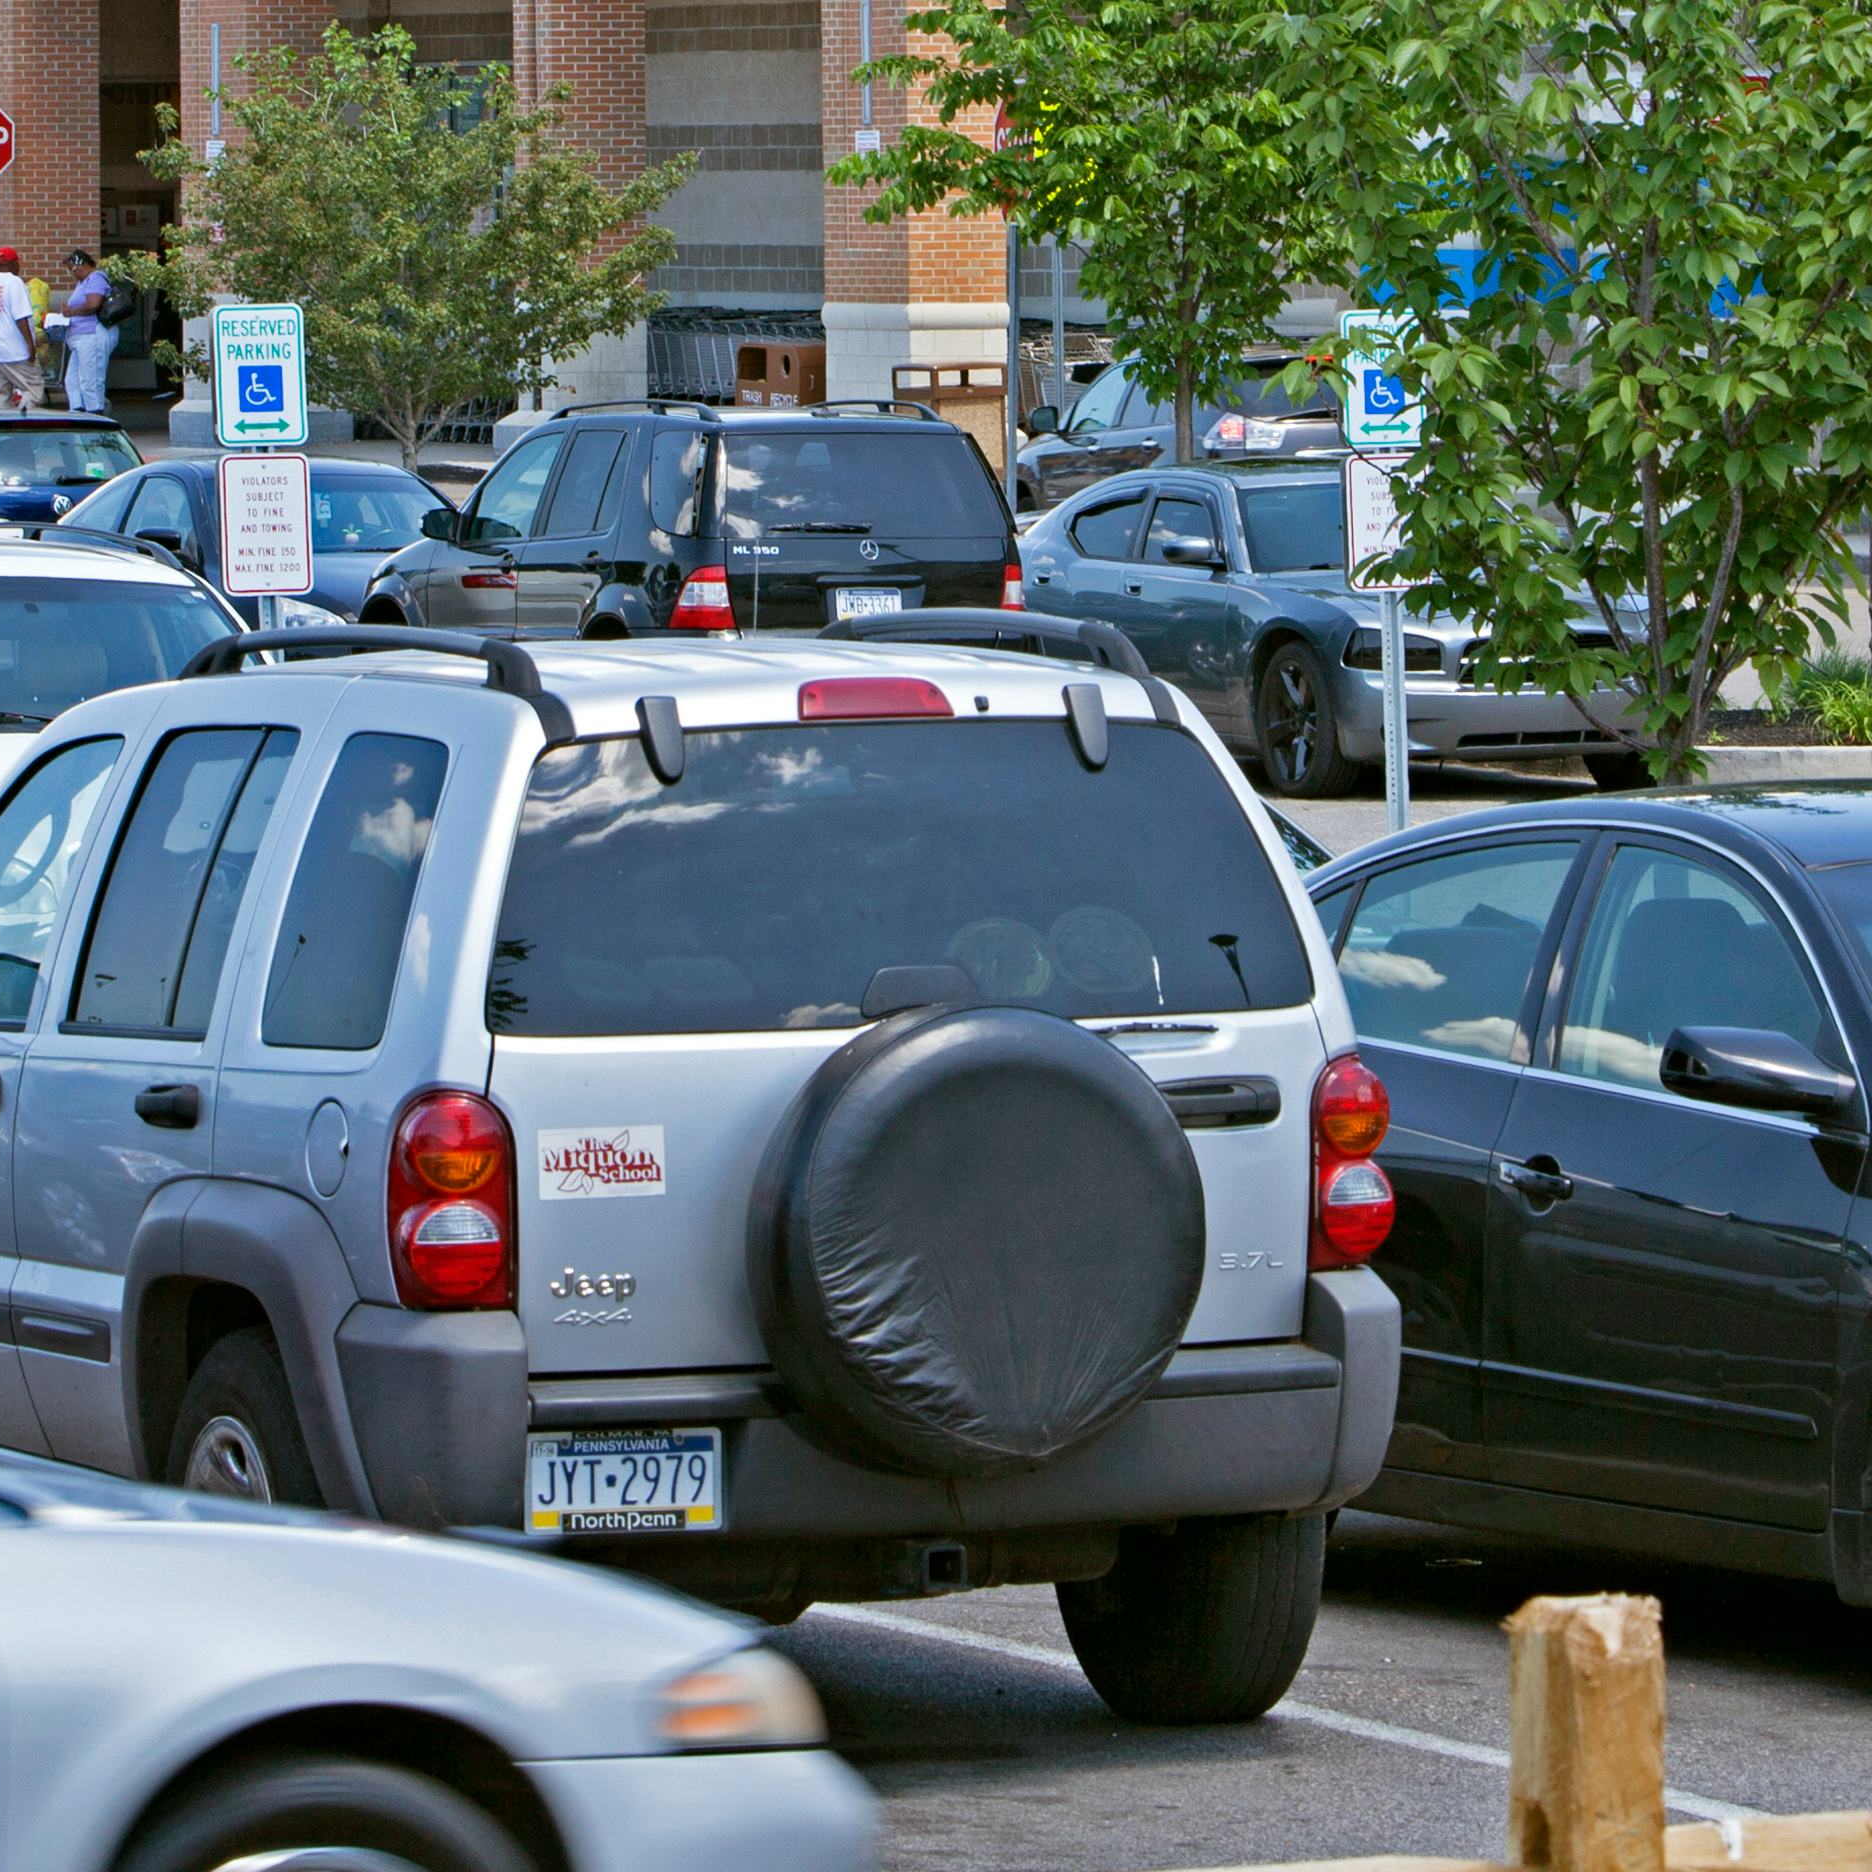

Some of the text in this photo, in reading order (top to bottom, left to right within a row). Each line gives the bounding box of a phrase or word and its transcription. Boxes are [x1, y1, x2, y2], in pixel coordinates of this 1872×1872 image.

[221, 319, 296, 337] RESERVED
[227, 343, 291, 360] PARKING
[241, 477, 289, 486] VIOLATORS
[245, 492, 284, 501] SUBJECT
[247, 508, 284, 517] TO FINE
[241, 524, 293, 533] AND TOWING
[1366, 524, 1381, 532] AND
[258, 547, 276, 556] FINE
[281, 547, 296, 556] $50
[256, 563, 275, 572] FINE
[280, 563, 301, 572] $200
[578, 1137, 613, 1152] The
[541, 1148, 658, 1176] Miquon
[599, 1165, 662, 1184] School
[1219, 1251, 1284, 1270] 3.7L
[549, 1267, 637, 1302] Jeep
[574, 1439, 670, 1453] PENNSYLVANIA
